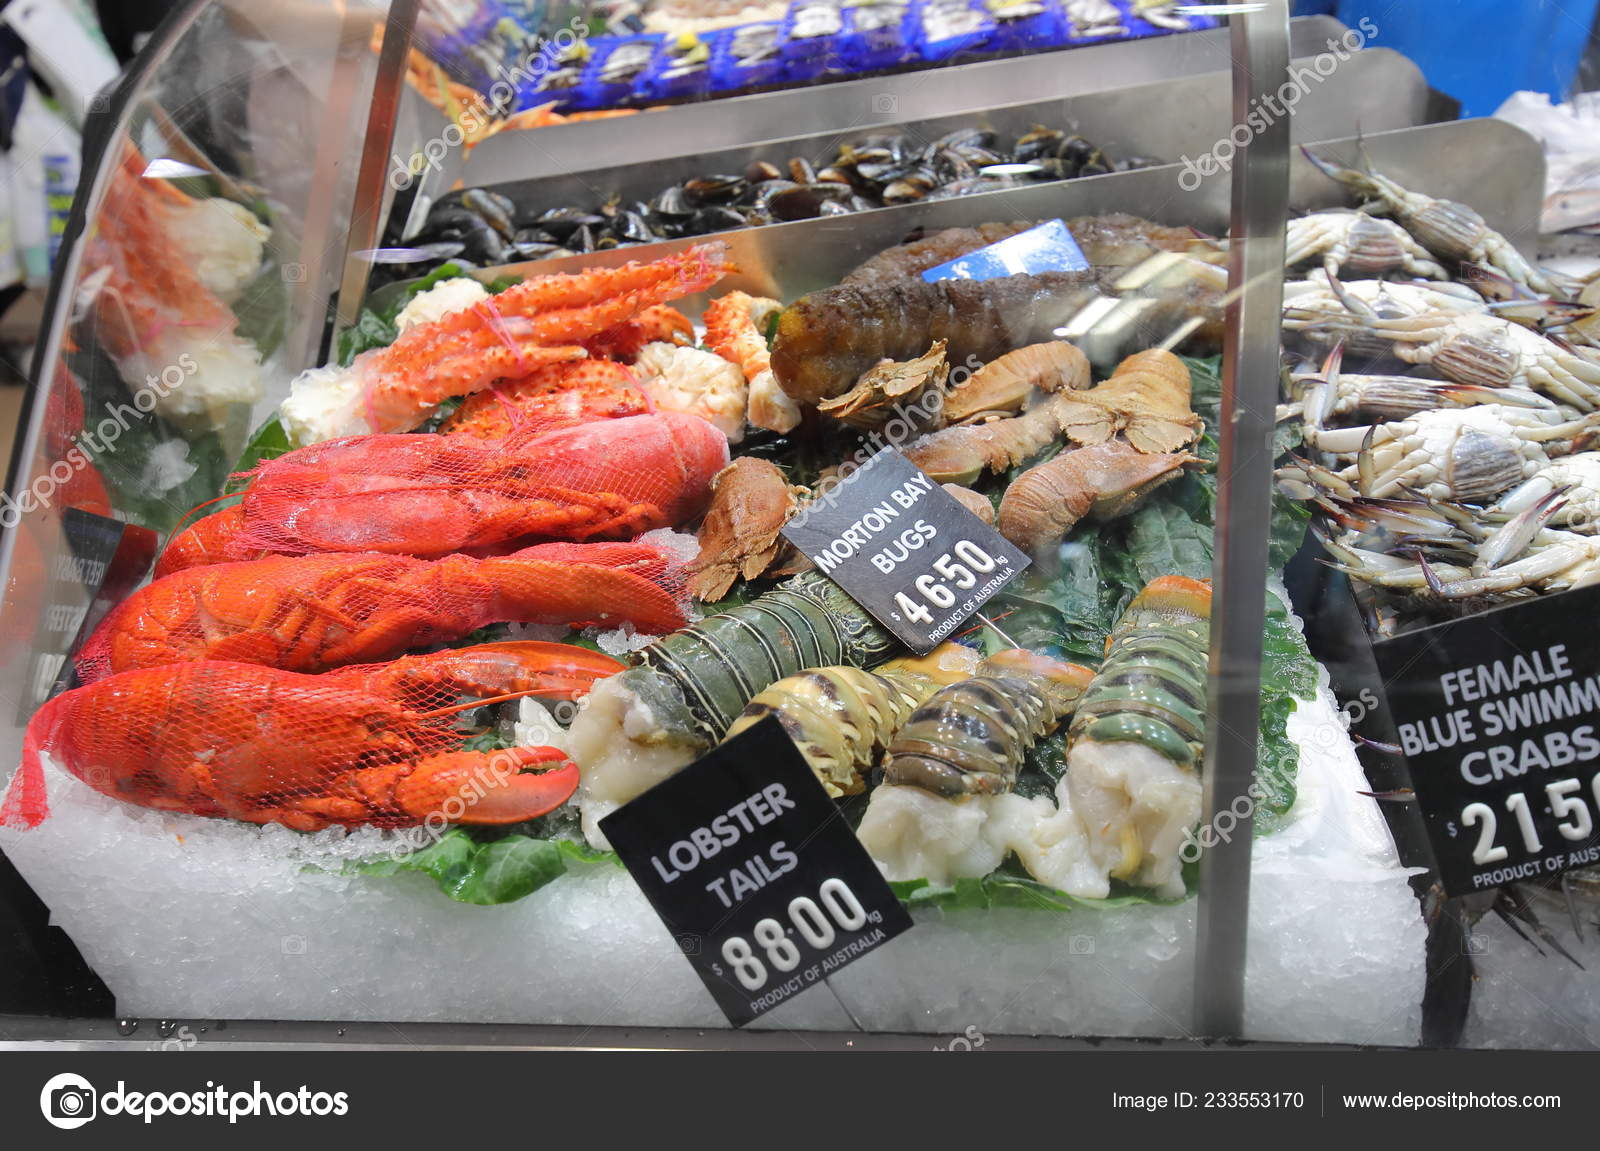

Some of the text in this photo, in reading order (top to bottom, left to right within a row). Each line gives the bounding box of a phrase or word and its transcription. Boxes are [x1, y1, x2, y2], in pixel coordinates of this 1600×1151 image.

[813, 471, 934, 575] MORTON BAY
[870, 519, 938, 575] BUGS
[928, 566, 1015, 643] PRODUCT OF AUSTRALIA
[1441, 644, 1573, 705] FEMALE
[1399, 675, 1600, 756] BLUE SWIMM
[1460, 725, 1600, 786] CRABS
[651, 782, 796, 883] LOBSTER
[1473, 846, 1600, 888] PRODUCT OF AUS
[705, 840, 798, 908] TAILS
[750, 928, 886, 1014] PRODUCT OF AUSTRALIA
